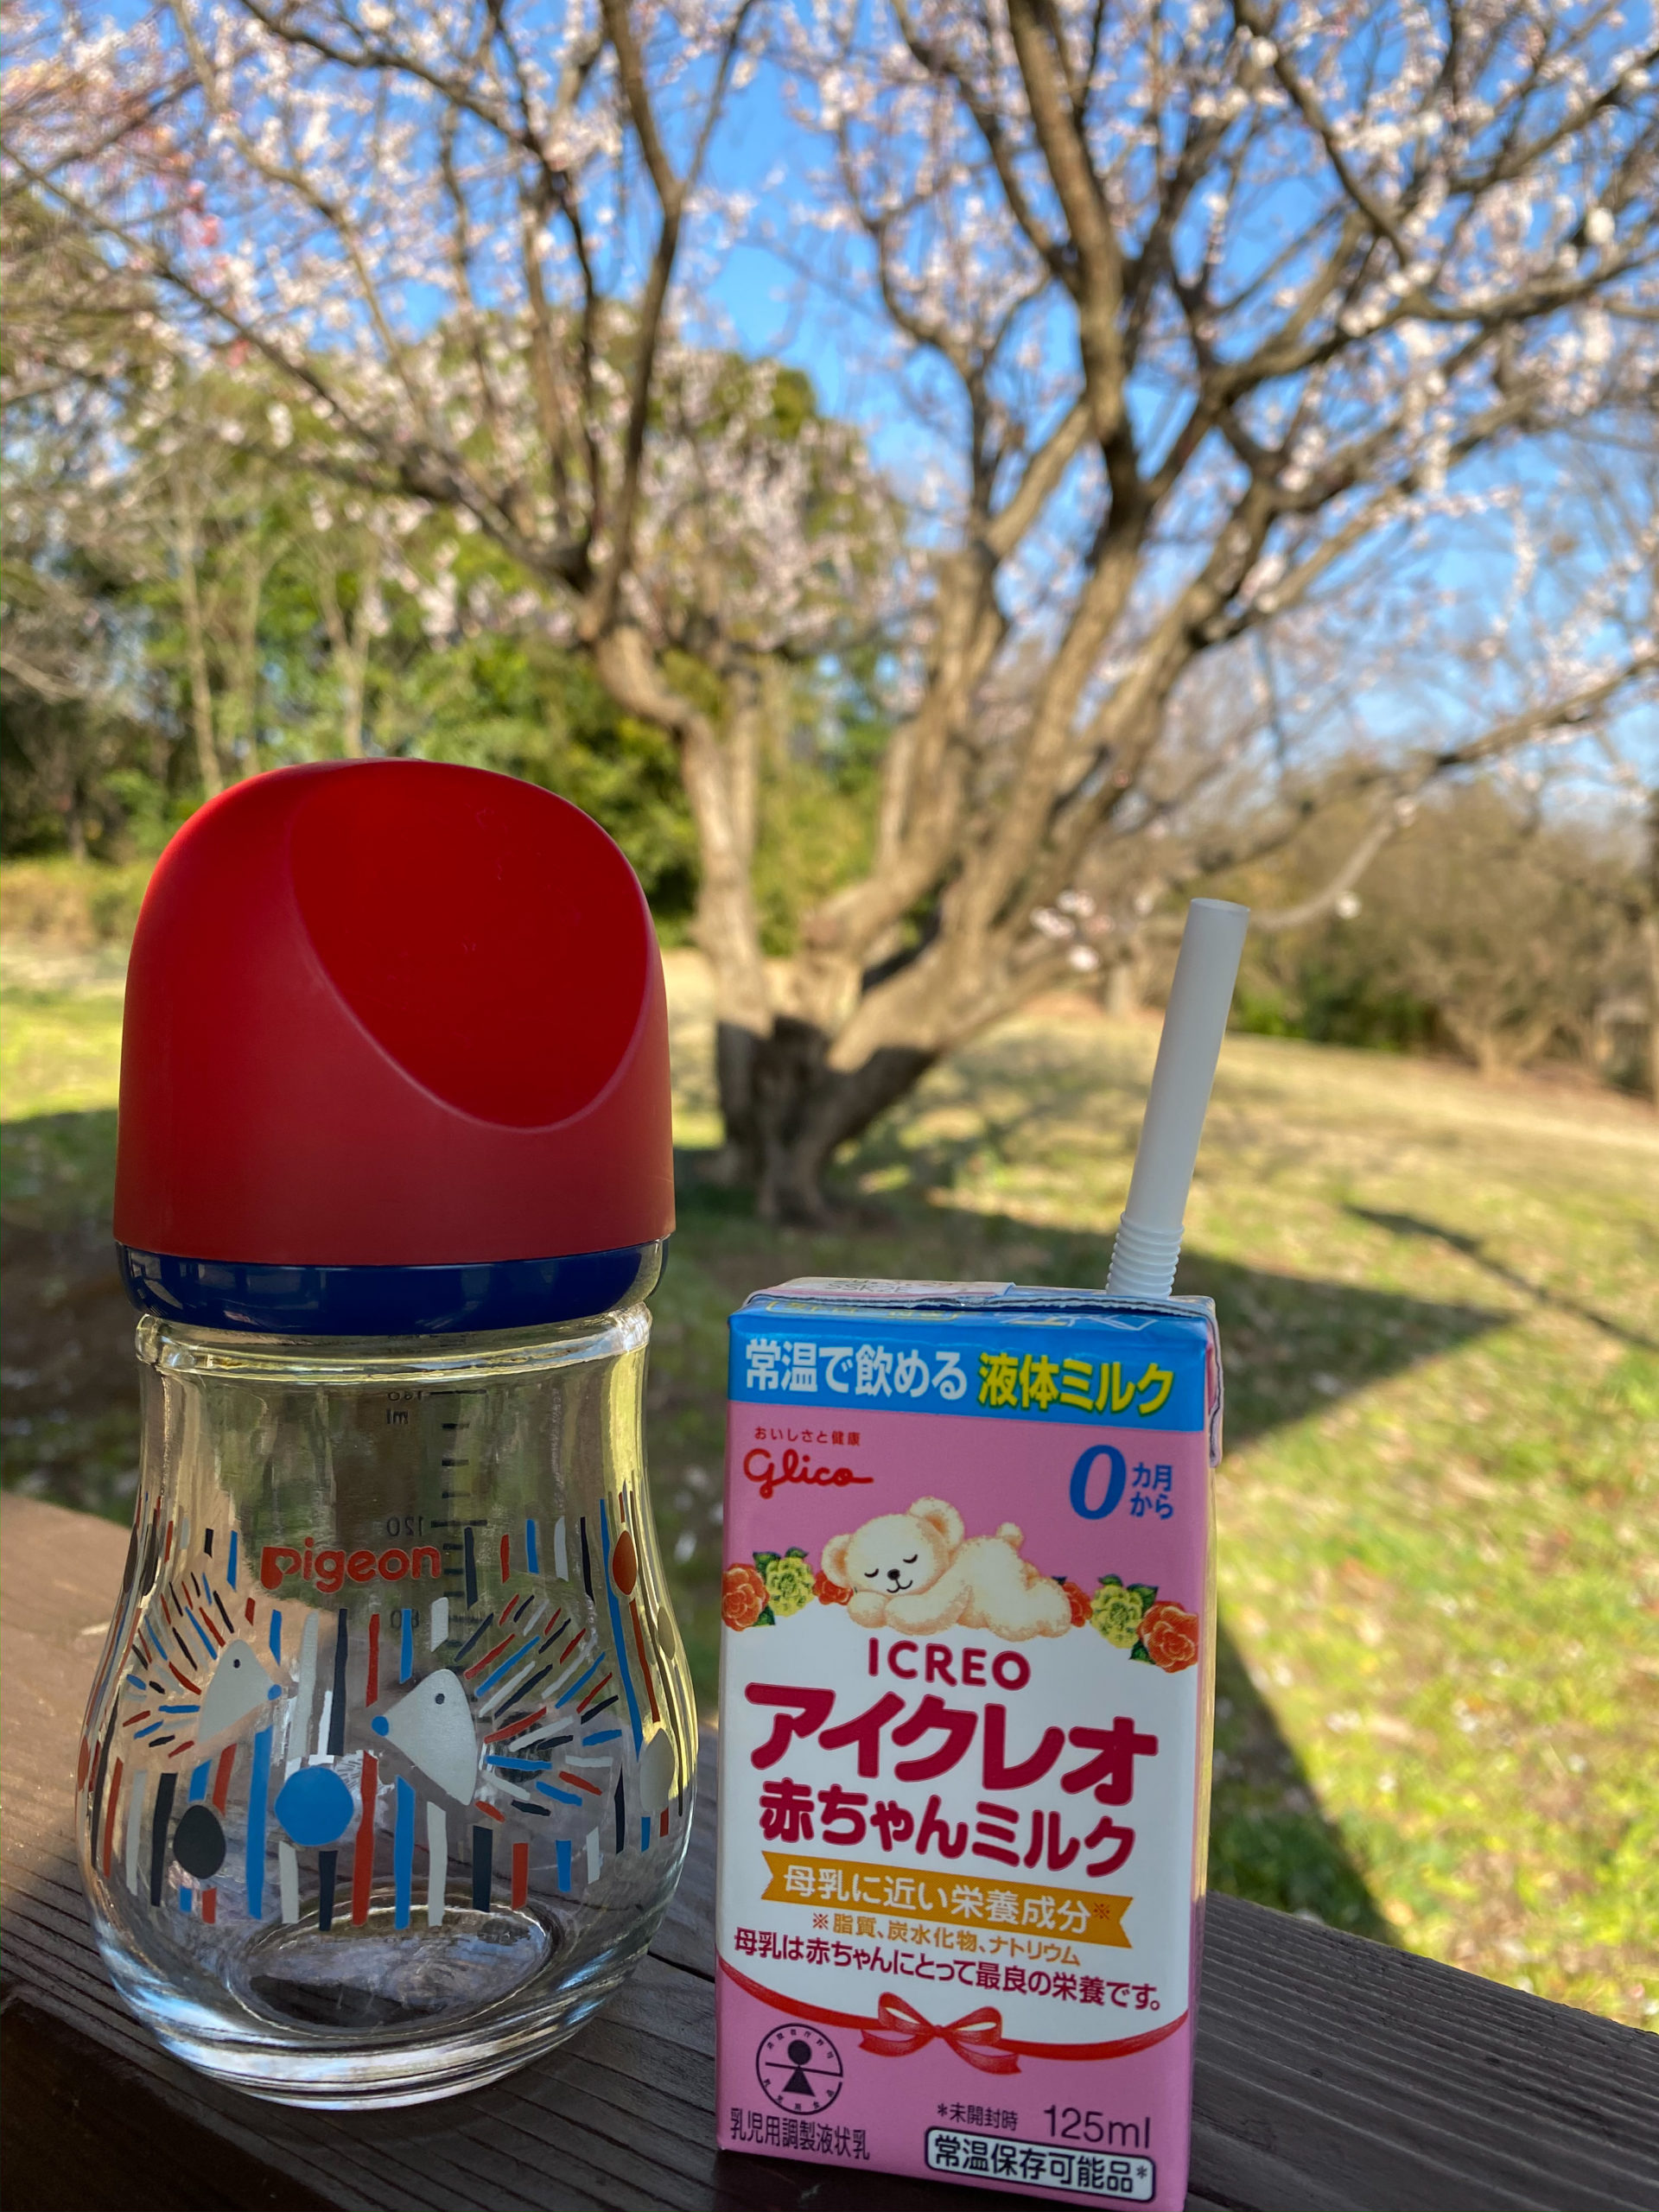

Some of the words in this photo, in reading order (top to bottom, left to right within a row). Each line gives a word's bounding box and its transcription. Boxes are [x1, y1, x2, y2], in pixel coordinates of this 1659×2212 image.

[745, 1338, 968, 1401] 常温で飲める
[977, 1352, 1175, 1416] 液体ミルク
[753, 1427, 861, 1446] おいしさと健康
[742, 1448, 874, 1499] Glico
[1069, 1444, 1127, 1520] 0
[1129, 1491, 1174, 1520] から
[260, 1537, 442, 1594] pigeon
[868, 1637, 1031, 1691] ICREO
[744, 1681, 1160, 1807] アイクレオ
[759, 1777, 1136, 1878] 赤ちゃんミルク
[734, 1927, 1160, 2012] 母乳は赤ちゃんにとって最良の栄養です。
[729, 2107, 870, 2160] 乳児用調製液状乳
[1043, 2104, 1151, 2150] 125ml
